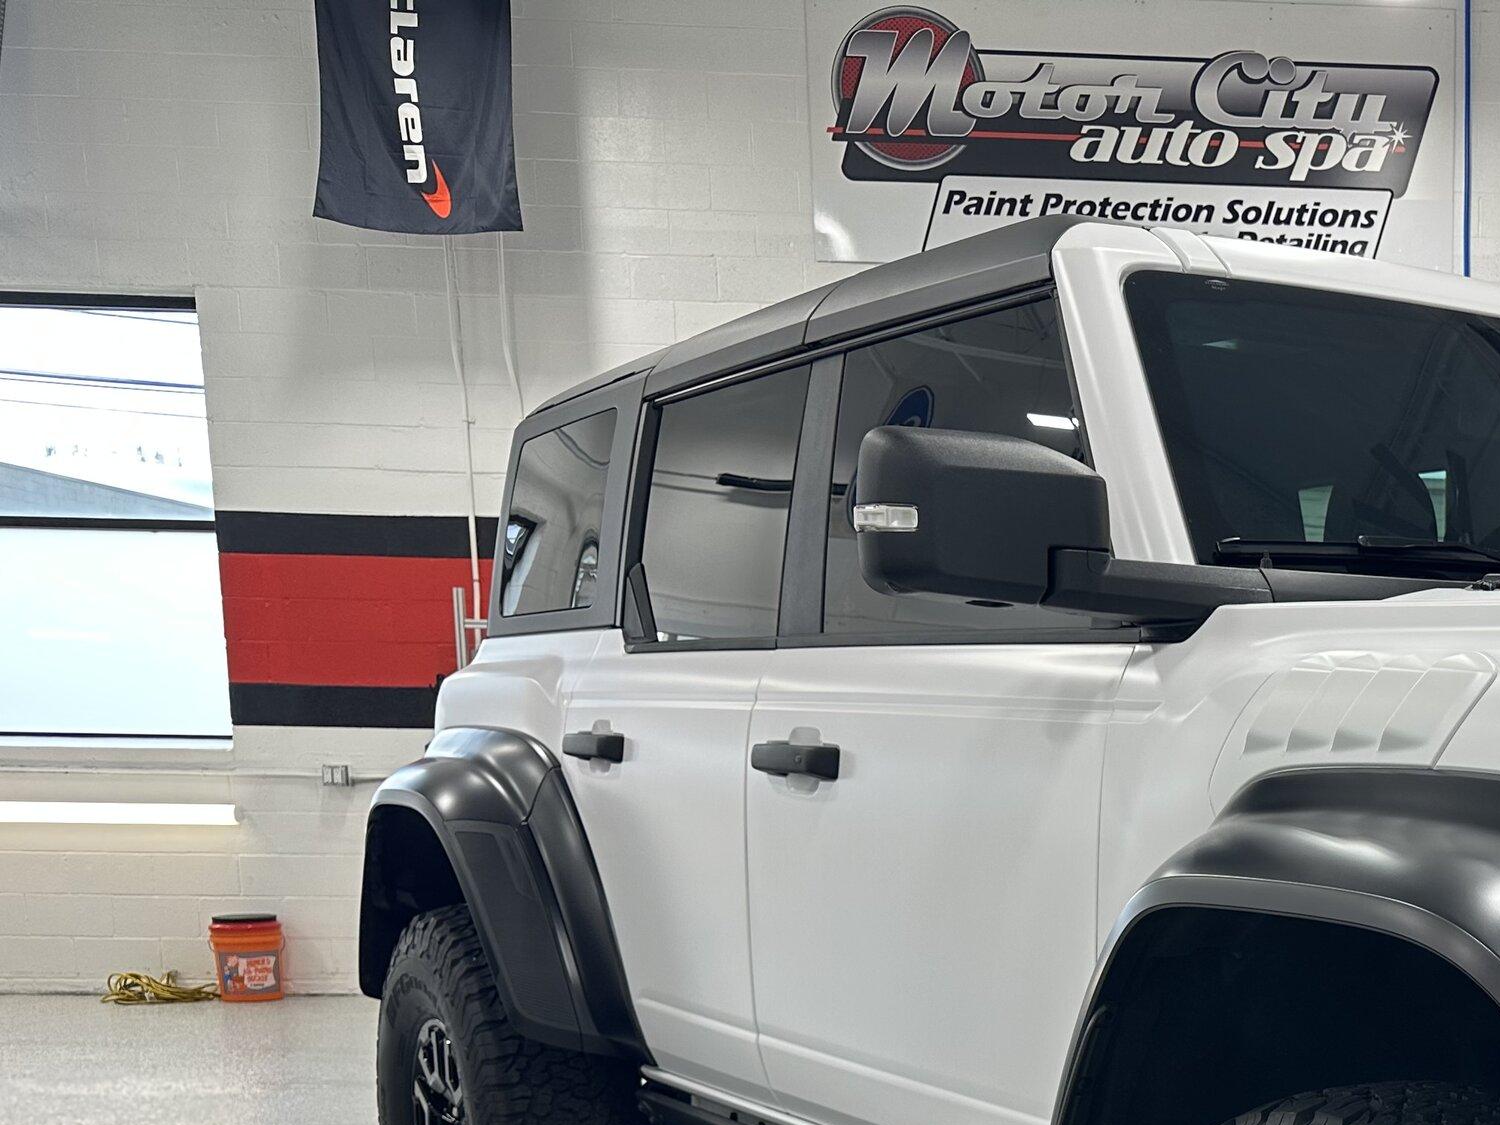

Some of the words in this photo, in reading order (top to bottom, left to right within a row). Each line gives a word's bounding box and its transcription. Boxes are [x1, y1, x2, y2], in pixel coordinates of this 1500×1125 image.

[390, 0, 428, 184] Laren
[845, 28, 1176, 137] Motor
[1194, 50, 1397, 136] City
[1069, 120, 1240, 168] auto
[1254, 130, 1393, 182] spa
[942, 189, 1034, 218] Paint
[1038, 192, 1216, 224] Protection
[1222, 199, 1378, 229] Solutions
